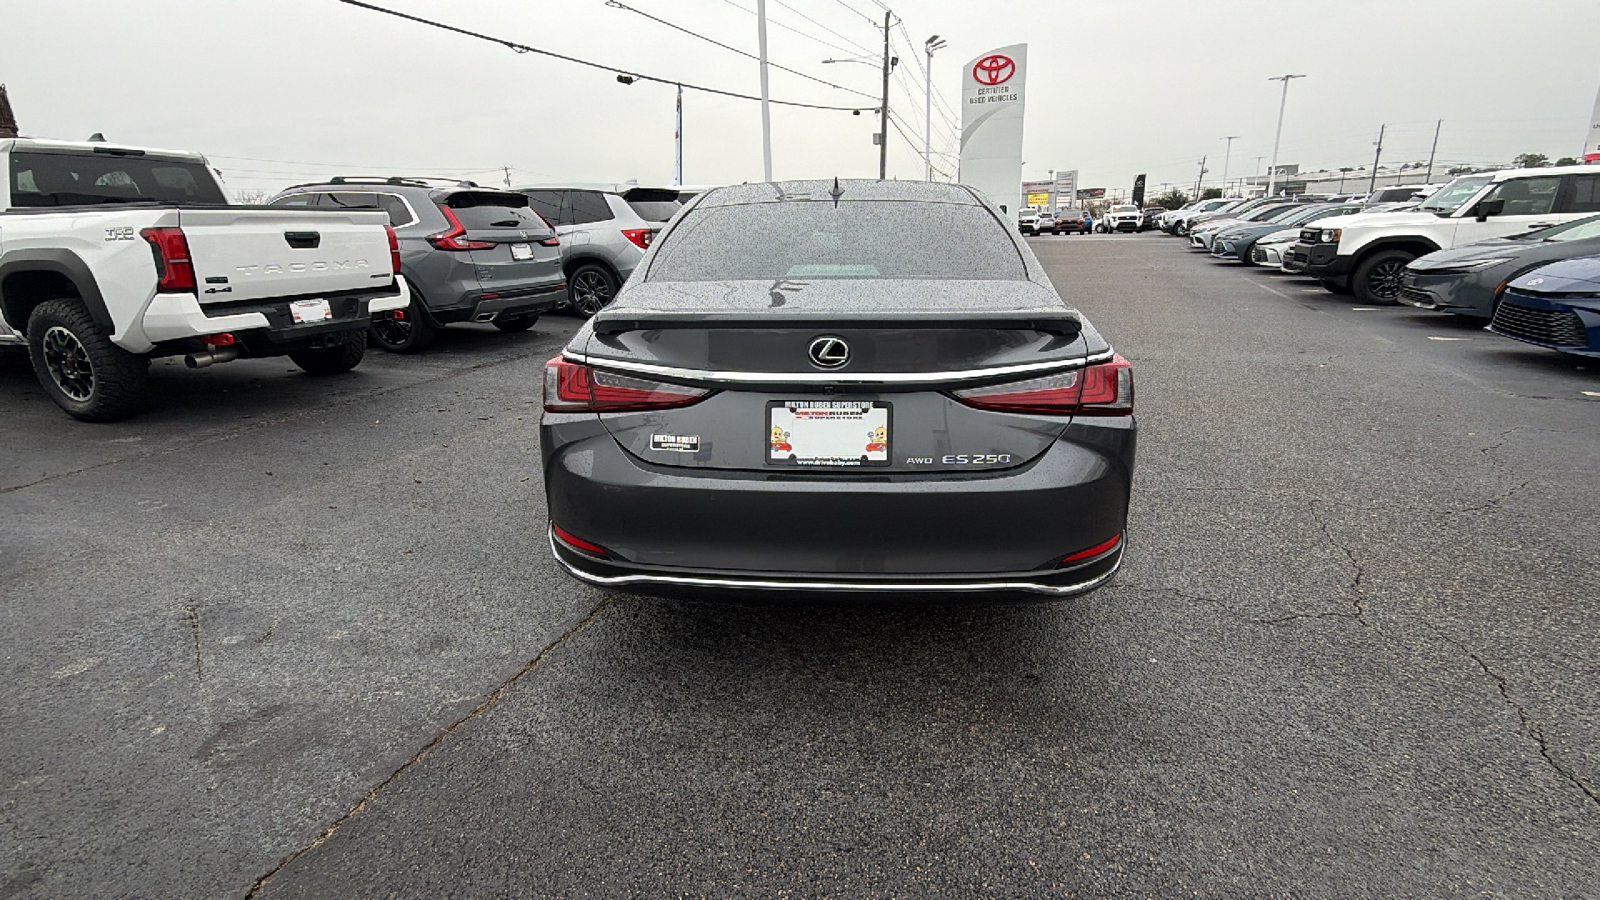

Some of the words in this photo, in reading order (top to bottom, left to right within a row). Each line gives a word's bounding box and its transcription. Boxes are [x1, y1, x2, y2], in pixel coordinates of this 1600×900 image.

[978, 86, 1009, 95] CERTIFIED
[969, 96, 986, 104] USED
[987, 94, 1017, 103] VEHICLES
[236, 258, 369, 276] TACOMA
[785, 401, 809, 409] MILTON
[810, 401, 831, 409] RUBEN
[832, 401, 874, 409] SUPERSTORE
[942, 454, 969, 464] ES
[972, 454, 1011, 464] 250
